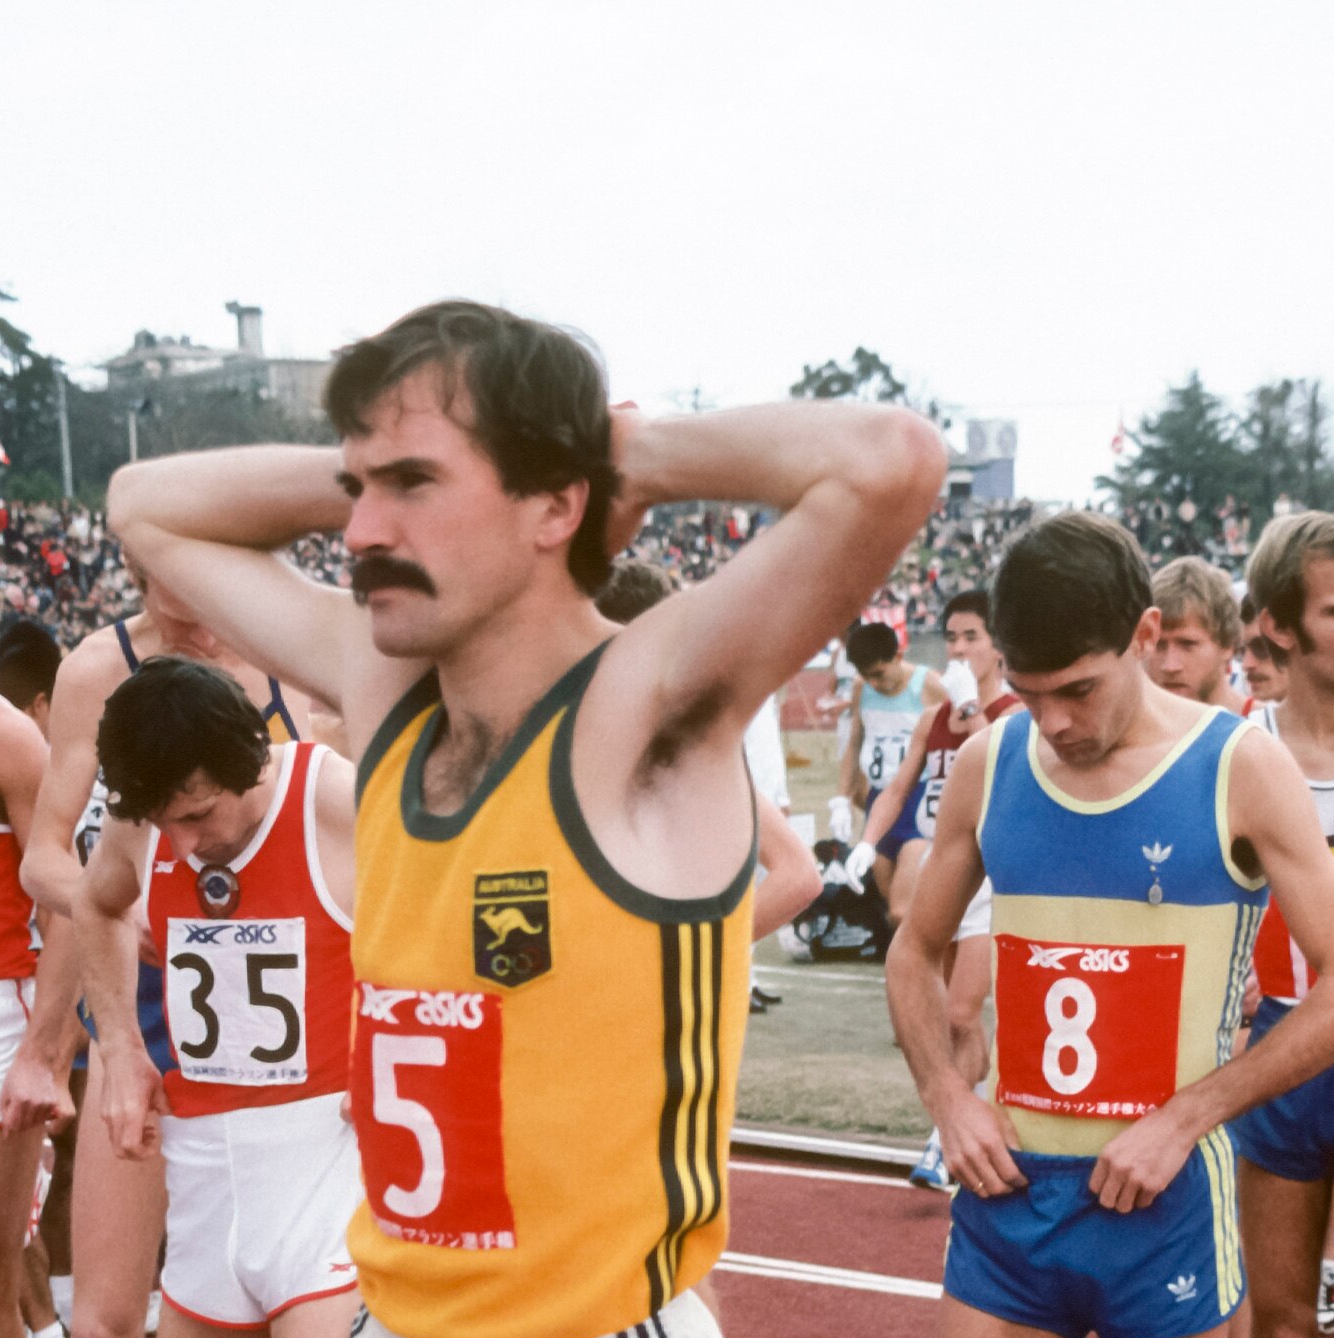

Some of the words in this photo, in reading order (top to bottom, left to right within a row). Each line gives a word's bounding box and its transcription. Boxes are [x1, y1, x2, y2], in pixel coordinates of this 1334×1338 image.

[234, 924, 277, 944] asics
[1079, 948, 1130, 973] asics
[170, 952, 301, 1064] 35
[414, 990, 484, 1029] asics
[1041, 977, 1098, 1096] 8
[372, 1033, 447, 1218] 5
